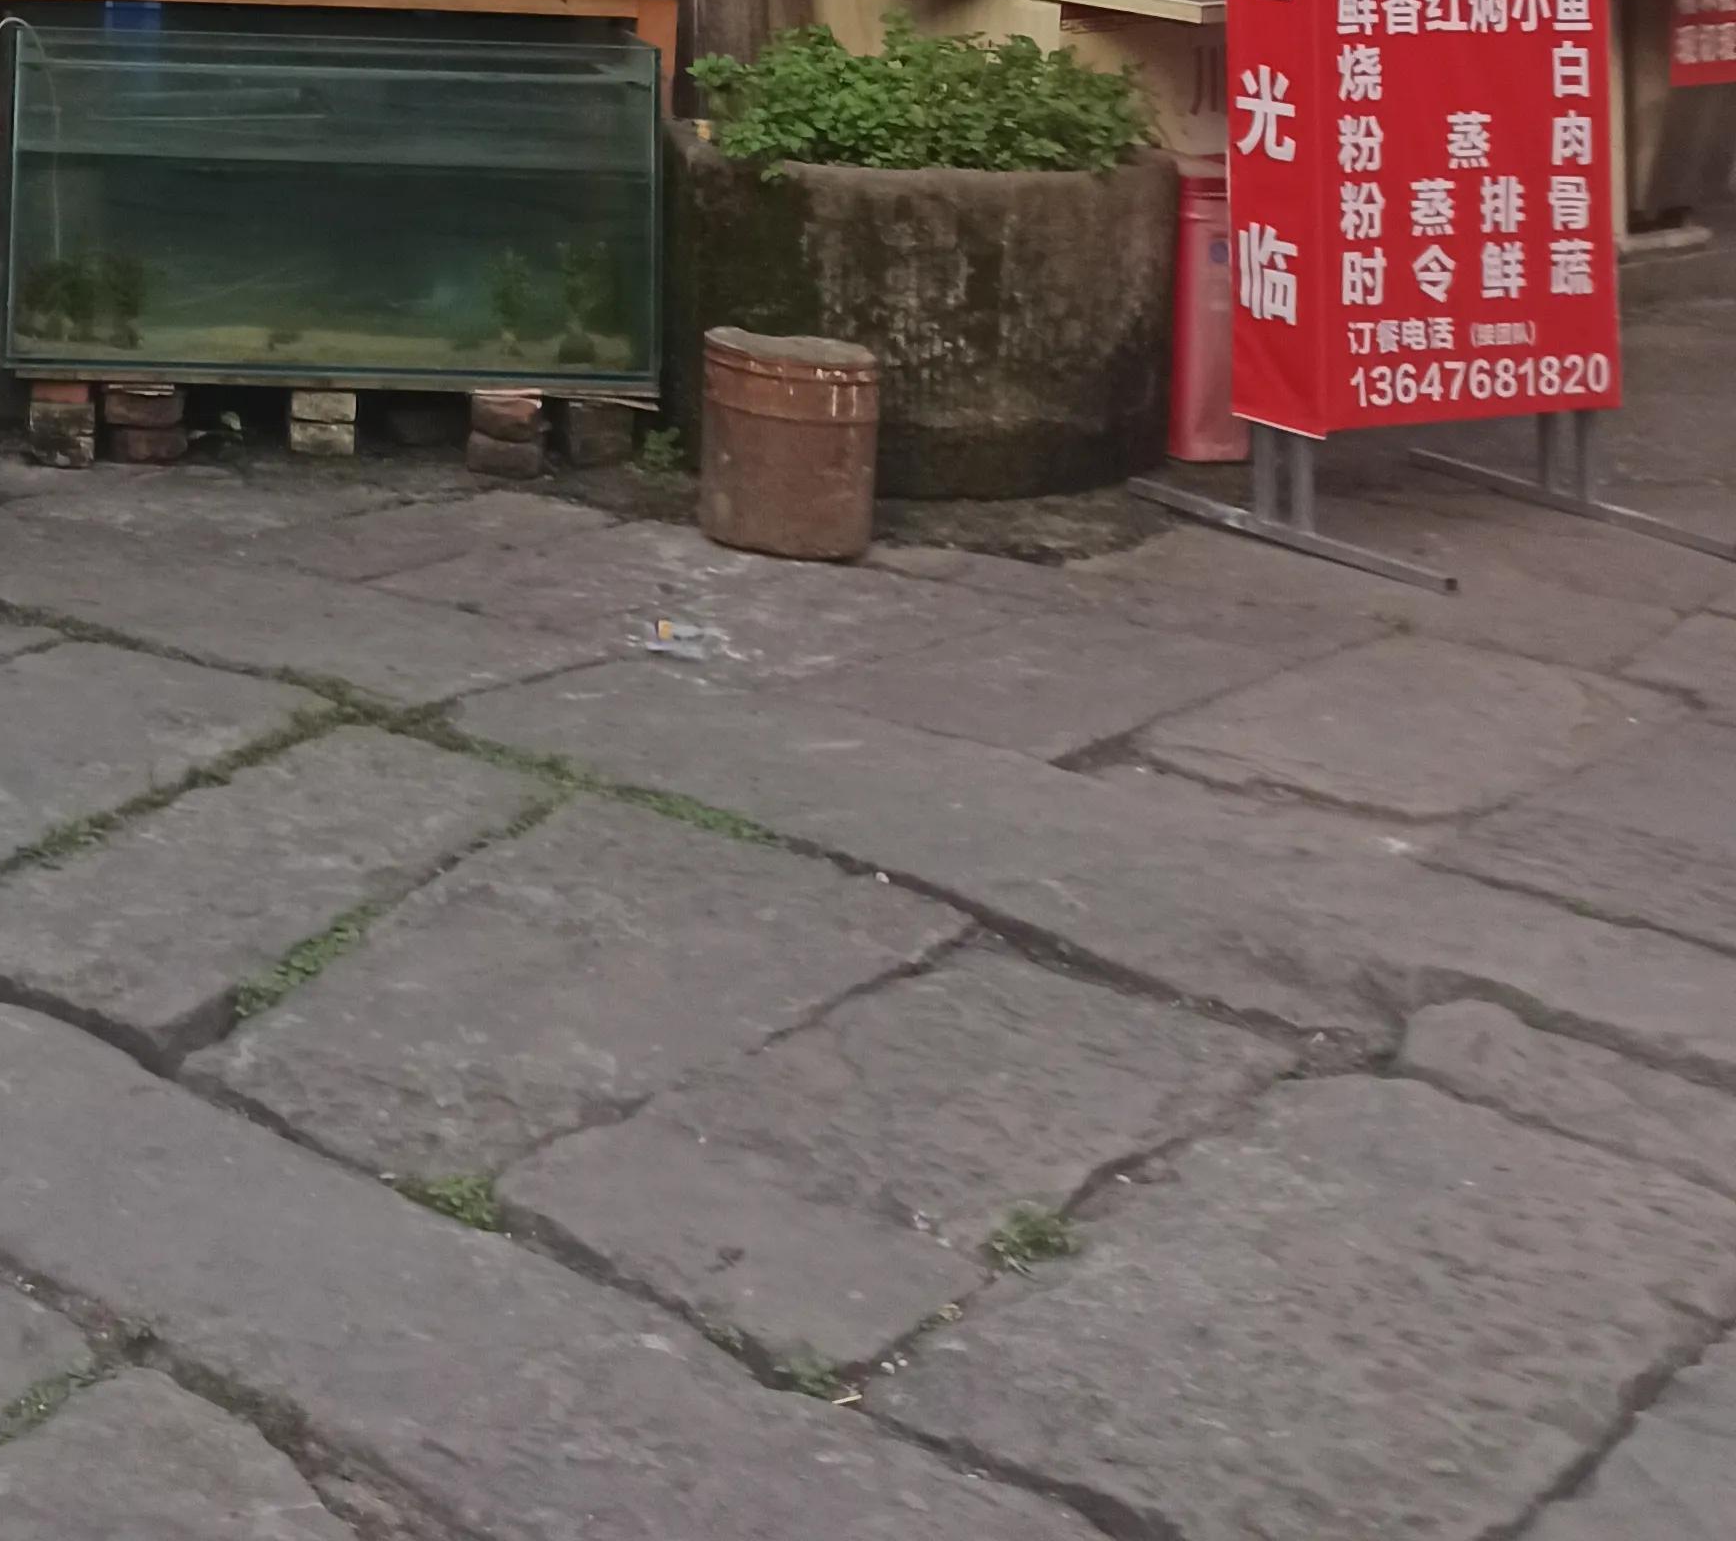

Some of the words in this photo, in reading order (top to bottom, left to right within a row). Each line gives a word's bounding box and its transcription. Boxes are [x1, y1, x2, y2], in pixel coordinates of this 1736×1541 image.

[1340, 176, 1591, 240] 粉蒸排骨
[1341, 239, 1595, 306] 时令鲜蔬
[1347, 317, 1455, 354] 订餐电话
[1350, 352, 1611, 408] 13647681820
